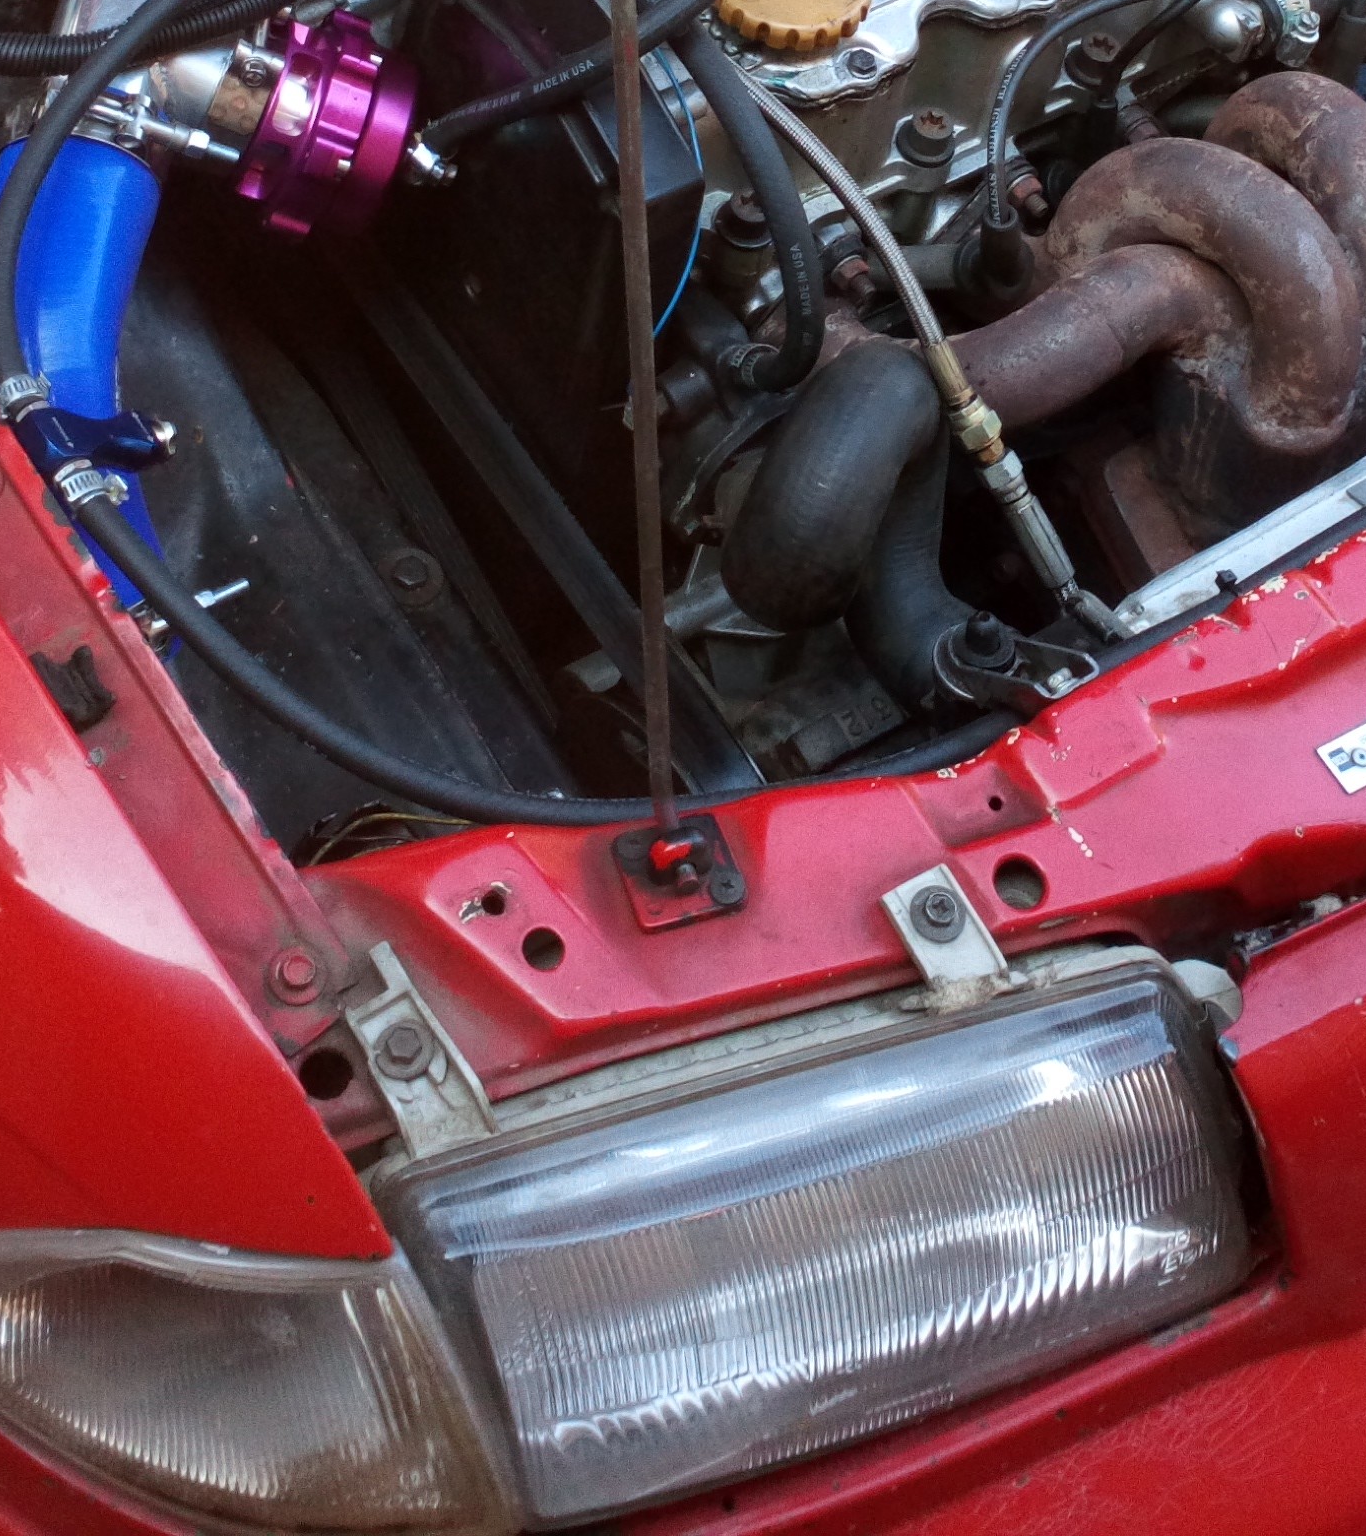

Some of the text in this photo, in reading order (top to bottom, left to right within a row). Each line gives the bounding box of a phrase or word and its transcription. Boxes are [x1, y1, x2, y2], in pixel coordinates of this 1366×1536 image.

[530, 58, 595, 94] MADE IN USA
[788, 241, 813, 315] MADE IN USA
